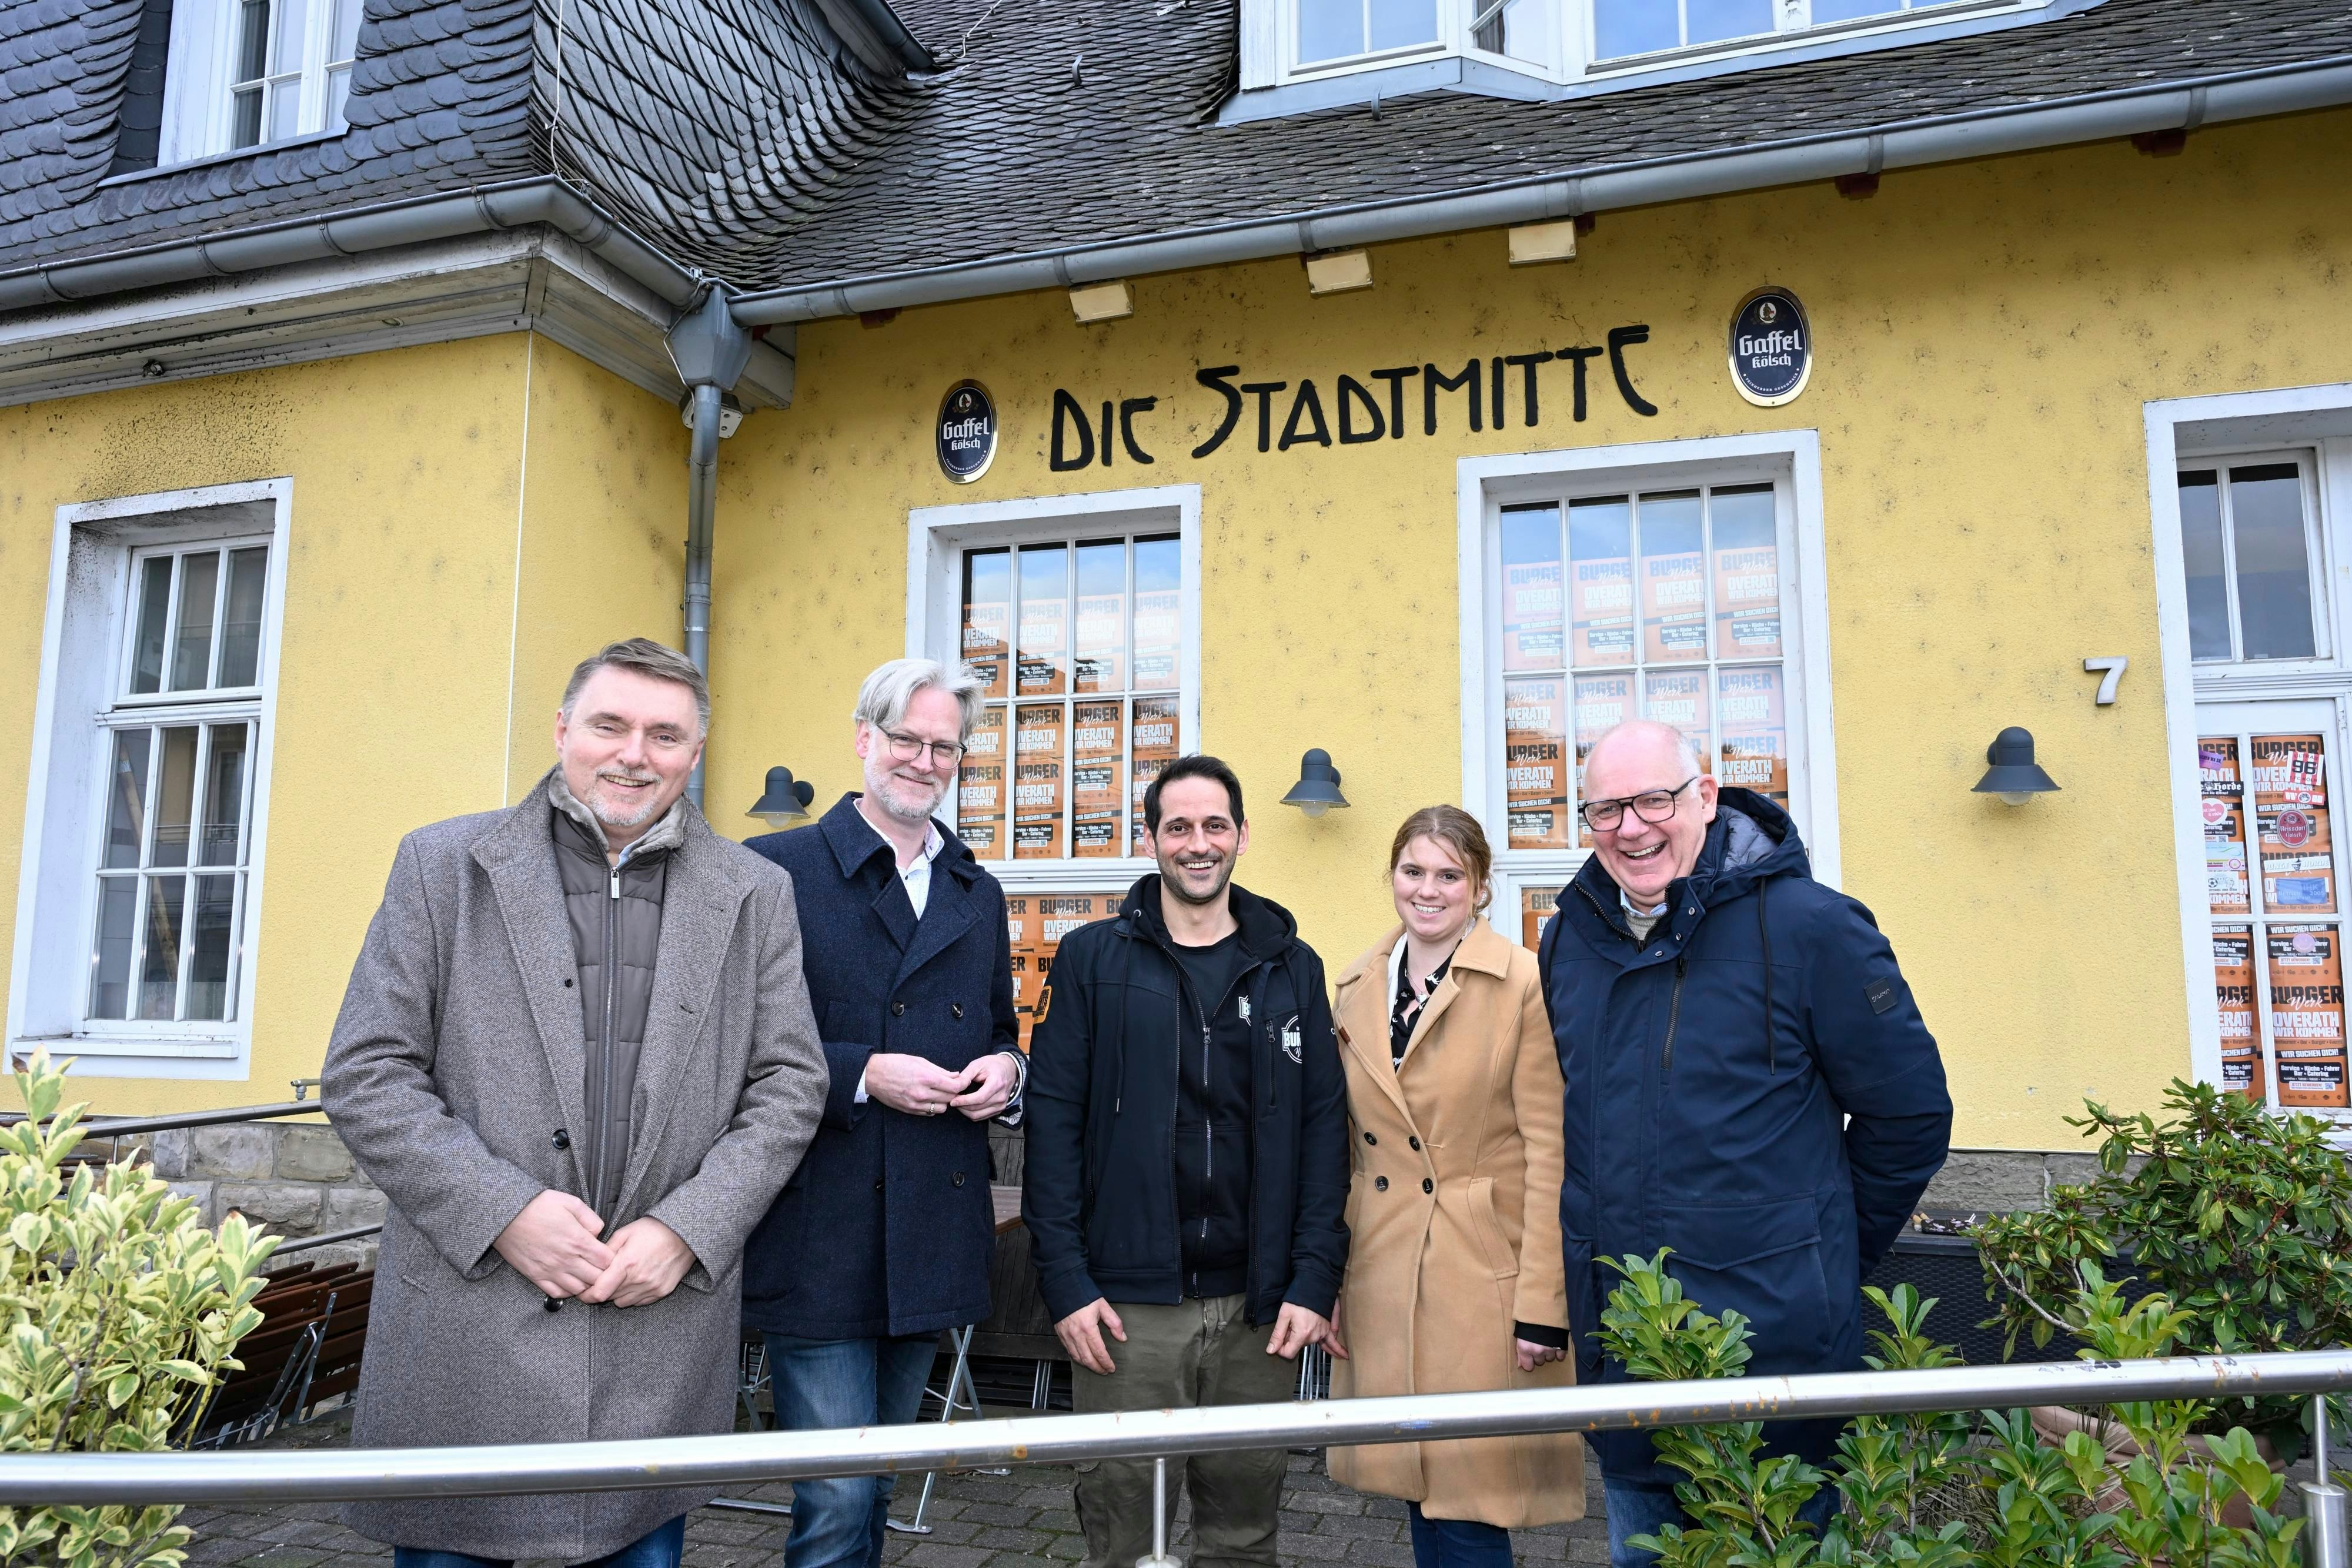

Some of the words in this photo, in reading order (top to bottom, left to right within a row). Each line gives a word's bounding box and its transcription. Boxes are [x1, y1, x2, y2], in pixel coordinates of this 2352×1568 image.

[1738, 329, 1803, 356] Gaffel
[1050, 389, 1155, 471] DIE
[1191, 324, 1658, 459] STADTMITTE
[943, 416, 990, 440] Gaffel
[1649, 557, 1702, 577] BURGE
[1721, 551, 1775, 570] BURGE
[1739, 560, 1770, 574] Werk
[1510, 566, 1561, 584] BURGE
[1579, 563, 1631, 581] BURGE
[1656, 579, 1704, 596] OVERAT
[1728, 574, 1778, 590] OVERAT
[1673, 613, 1693, 621] SUCHEN
[1745, 608, 1765, 616] SUCHEN
[963, 626, 1000, 640] VERATH
[971, 638, 999, 647] KOMMEN!
[2083, 656, 2129, 706] 7
[1511, 693, 1538, 706] Werk
[1018, 709, 1060, 724] URGER
[1075, 706, 1119, 723] URGER
[1134, 703, 1177, 719] URGER
[1138, 711, 1162, 724] Werk
[1506, 706, 1551, 721] VERATH
[1024, 717, 1046, 729] Werk
[1080, 715, 1104, 727] Werk
[1017, 729, 1055, 743] VERATH
[1074, 727, 1114, 741] VERATH
[1133, 724, 1172, 737] VERATH
[1027, 741, 1054, 750] KOMMEN!
[1084, 739, 1114, 748] KOMMEN!
[1142, 736, 1172, 745] KOMMEN!
[970, 744, 998, 753] KOMMEN!
[1507, 744, 1558, 761] URGER
[1514, 753, 1541, 766] Werk
[960, 766, 1001, 781] URGER
[1017, 763, 1058, 779] URGER
[1722, 760, 1772, 774] VERATH
[2291, 760, 2317, 775] 96
[965, 774, 988, 785] Werk
[1021, 772, 1045, 784] Werk
[1519, 780, 1553, 790] KOMMEN!
[1735, 773, 1772, 783] KOMMEN!
[960, 786, 997, 799] VERATH
[1015, 784, 1054, 797] VERATH
[2214, 782, 2241, 792] Horde
[968, 798, 996, 806] KOMMEN!
[1025, 796, 1054, 805] KOMMEN!
[1039, 899, 1091, 914] BURGER
[1053, 907, 1077, 919] Werk
[1044, 932, 1057, 941] WIR
[2270, 985, 2343, 1004] BURGER
[2287, 996, 2323, 1011] Werk
[2272, 1011, 2339, 1027] OVERATH
[2273, 1027, 2294, 1037] WIR
[2296, 1027, 2340, 1037] KOMMEN!
